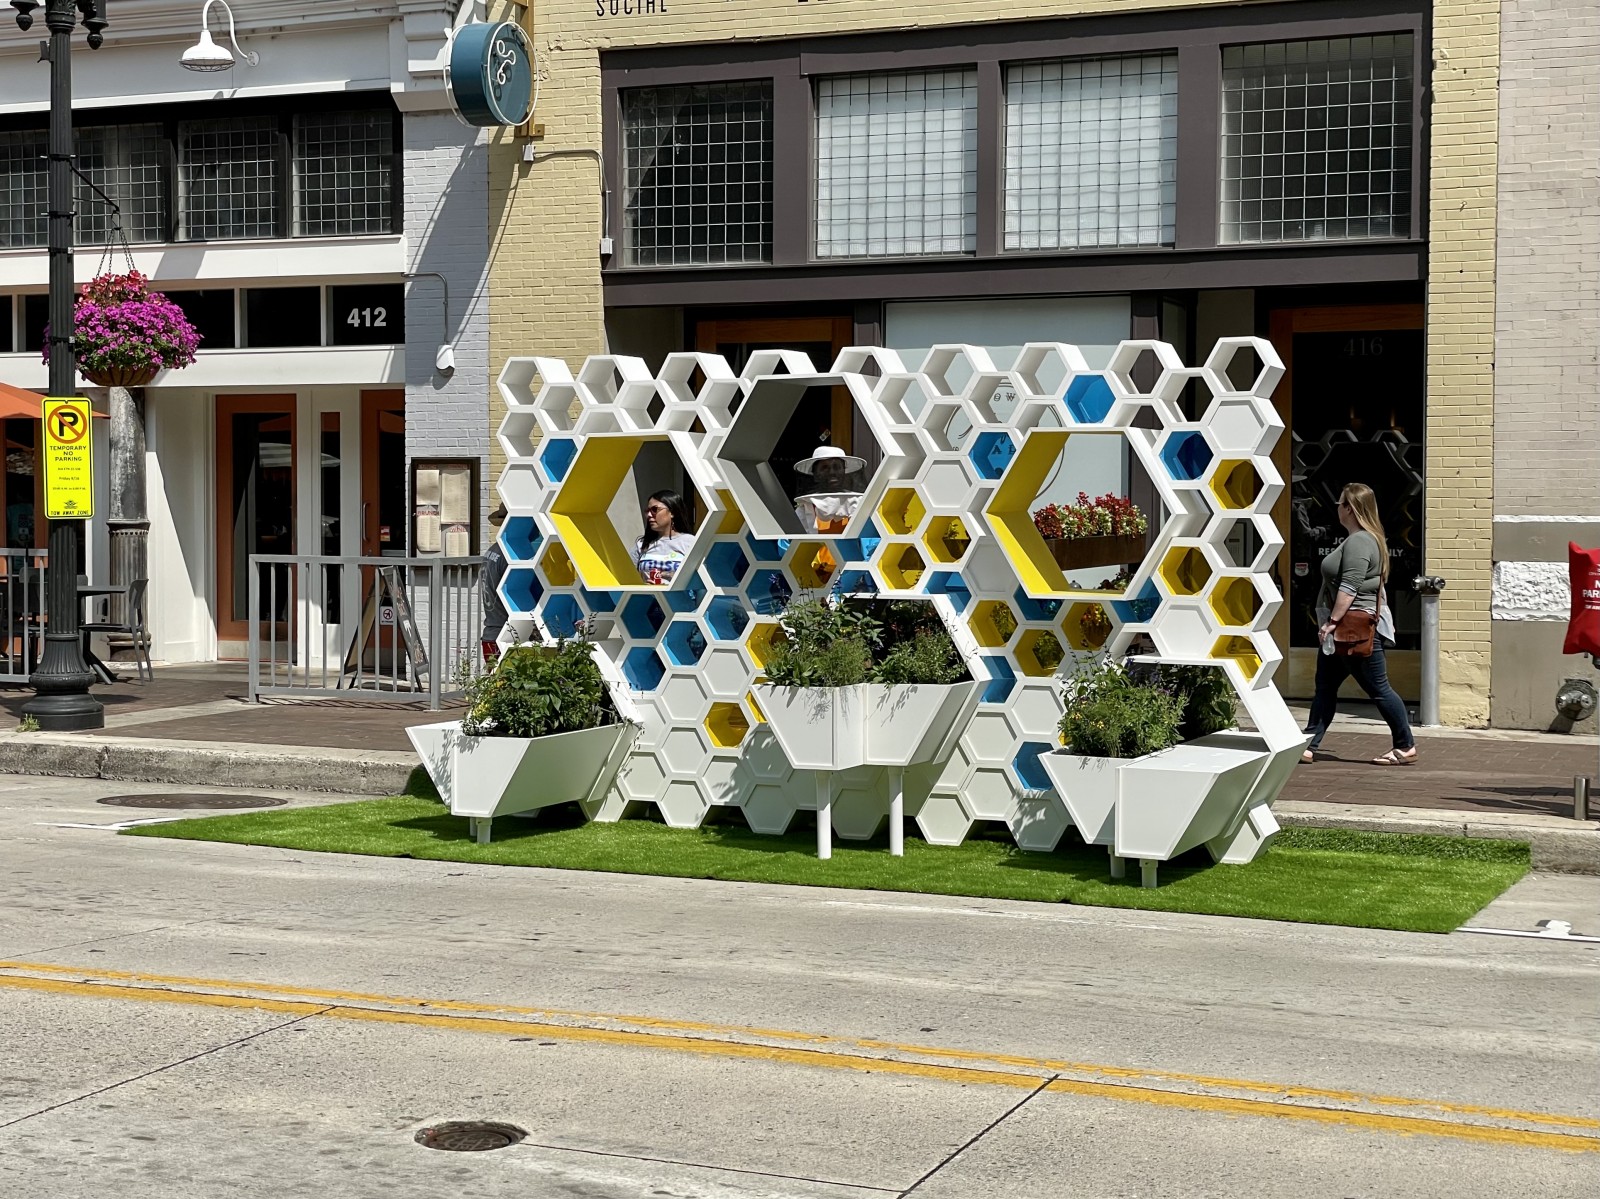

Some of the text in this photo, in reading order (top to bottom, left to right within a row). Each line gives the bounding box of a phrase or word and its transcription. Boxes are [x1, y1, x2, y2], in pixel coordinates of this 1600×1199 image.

[596, 0, 668, 17] SOCIAL
[346, 306, 387, 328] 412
[1343, 336, 1384, 356] 416
[1582, 589, 1600, 598] PAR
